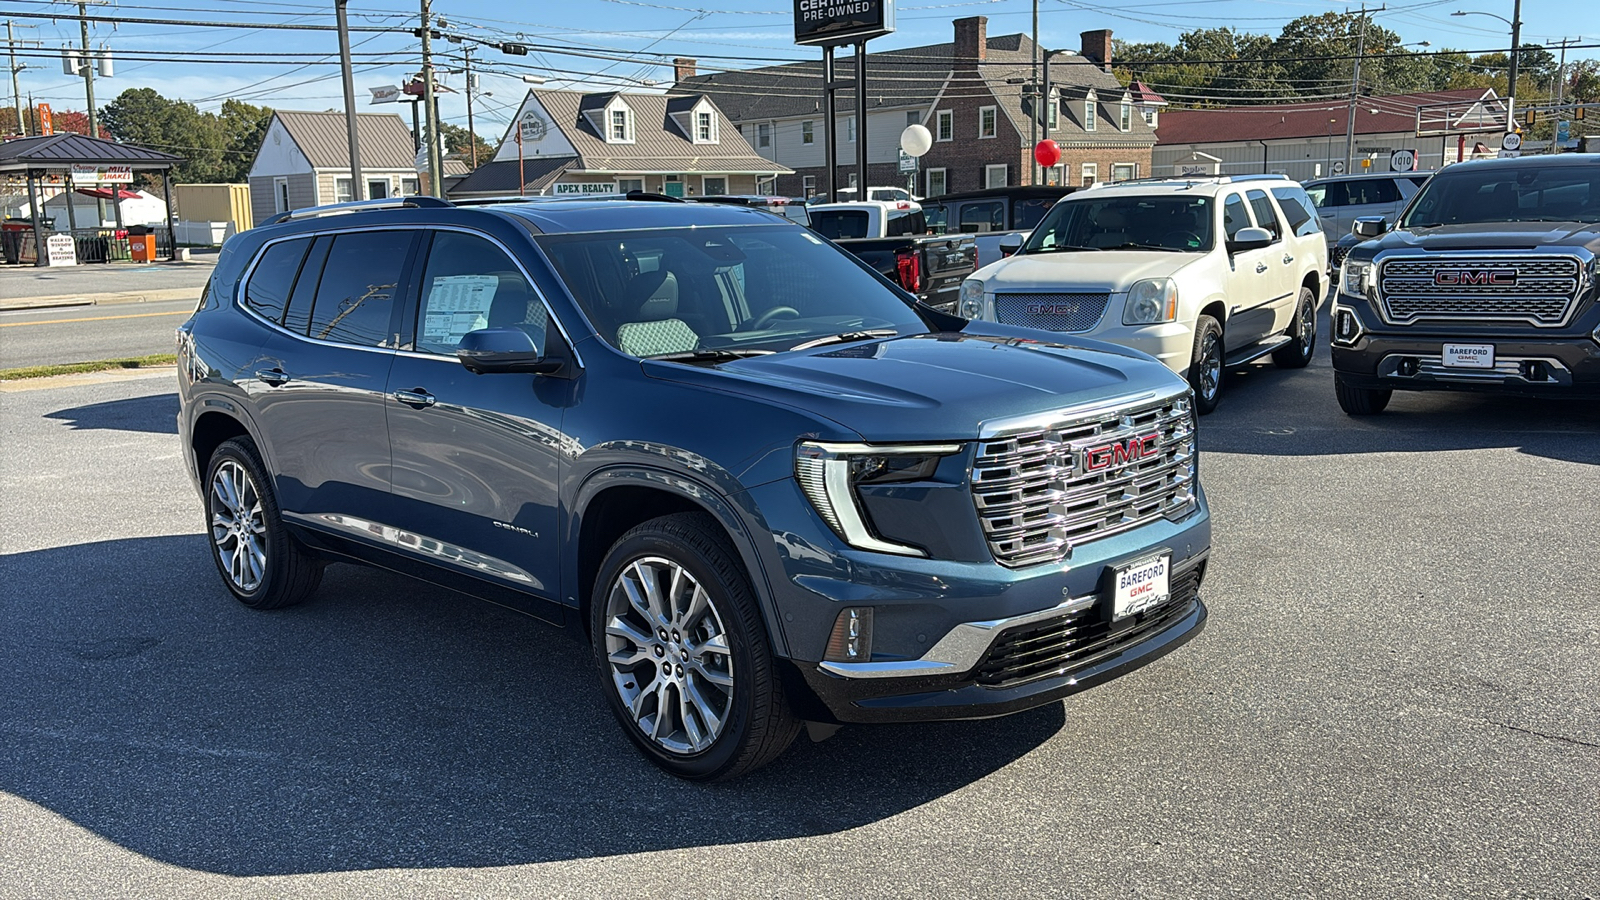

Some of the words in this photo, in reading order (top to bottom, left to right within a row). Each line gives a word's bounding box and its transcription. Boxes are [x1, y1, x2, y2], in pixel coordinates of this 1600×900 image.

[803, 2, 869, 21] PRE-OWNED
[1394, 156, 1412, 166] 1010
[557, 184, 580, 194] APEX
[582, 184, 614, 193] REALTY
[1435, 271, 1515, 285] GMC
[1026, 304, 1068, 314] GMC
[1086, 433, 1159, 471] GMC
[493, 521, 539, 538] DENALI
[1120, 563, 1164, 590] BAREFORD
[1130, 582, 1153, 598] GMC
